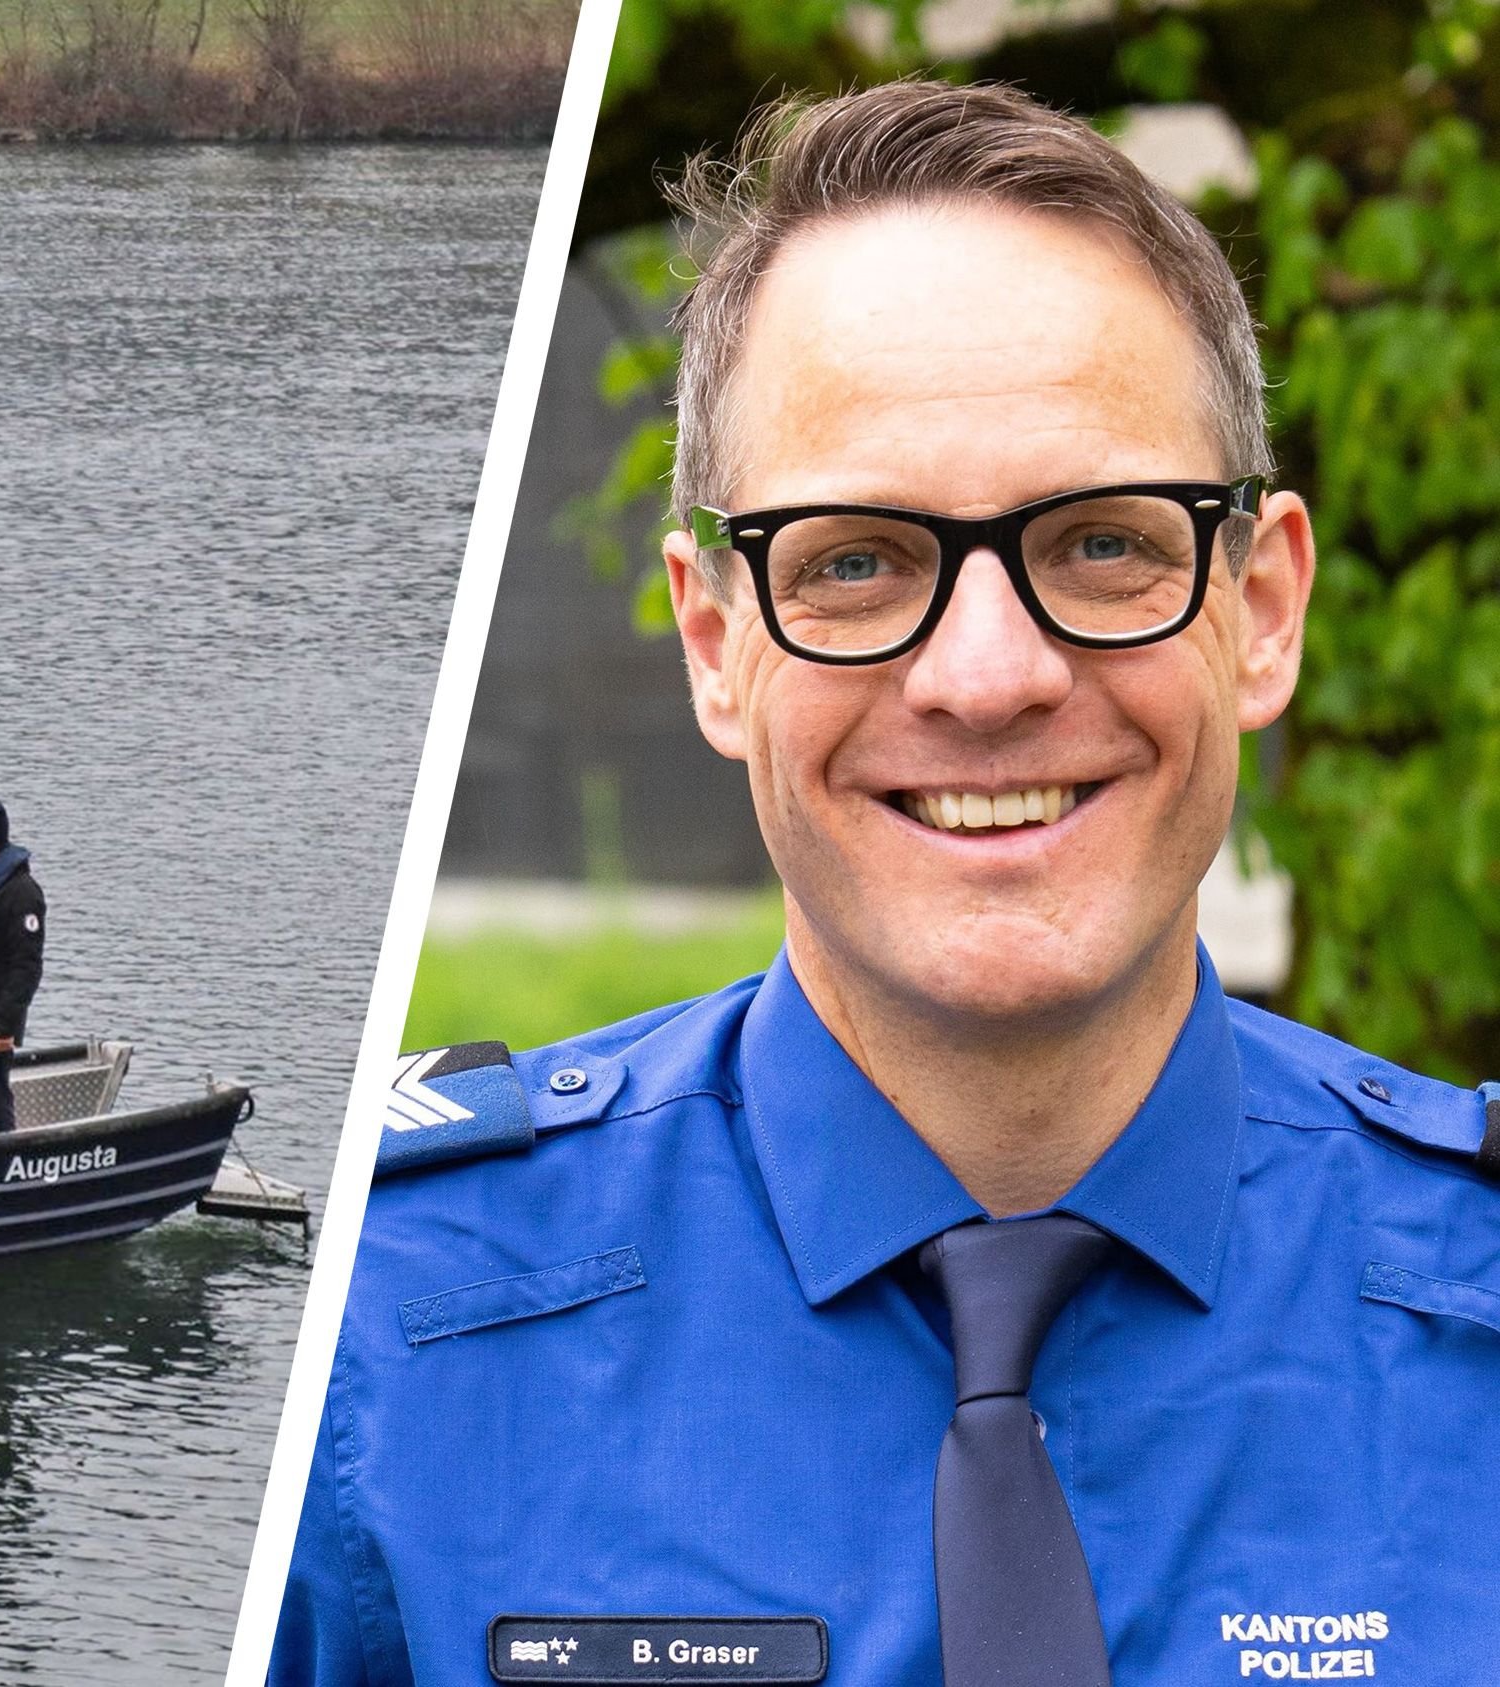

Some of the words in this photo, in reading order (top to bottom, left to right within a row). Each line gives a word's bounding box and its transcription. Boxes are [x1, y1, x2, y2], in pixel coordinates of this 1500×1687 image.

[4, 1145, 117, 1183] Augusta
[1220, 1611, 1390, 1644] KANTONS
[632, 1639, 661, 1664] B.
[668, 1639, 760, 1664] Graser
[1240, 1649, 1376, 1679] POLIZEI
